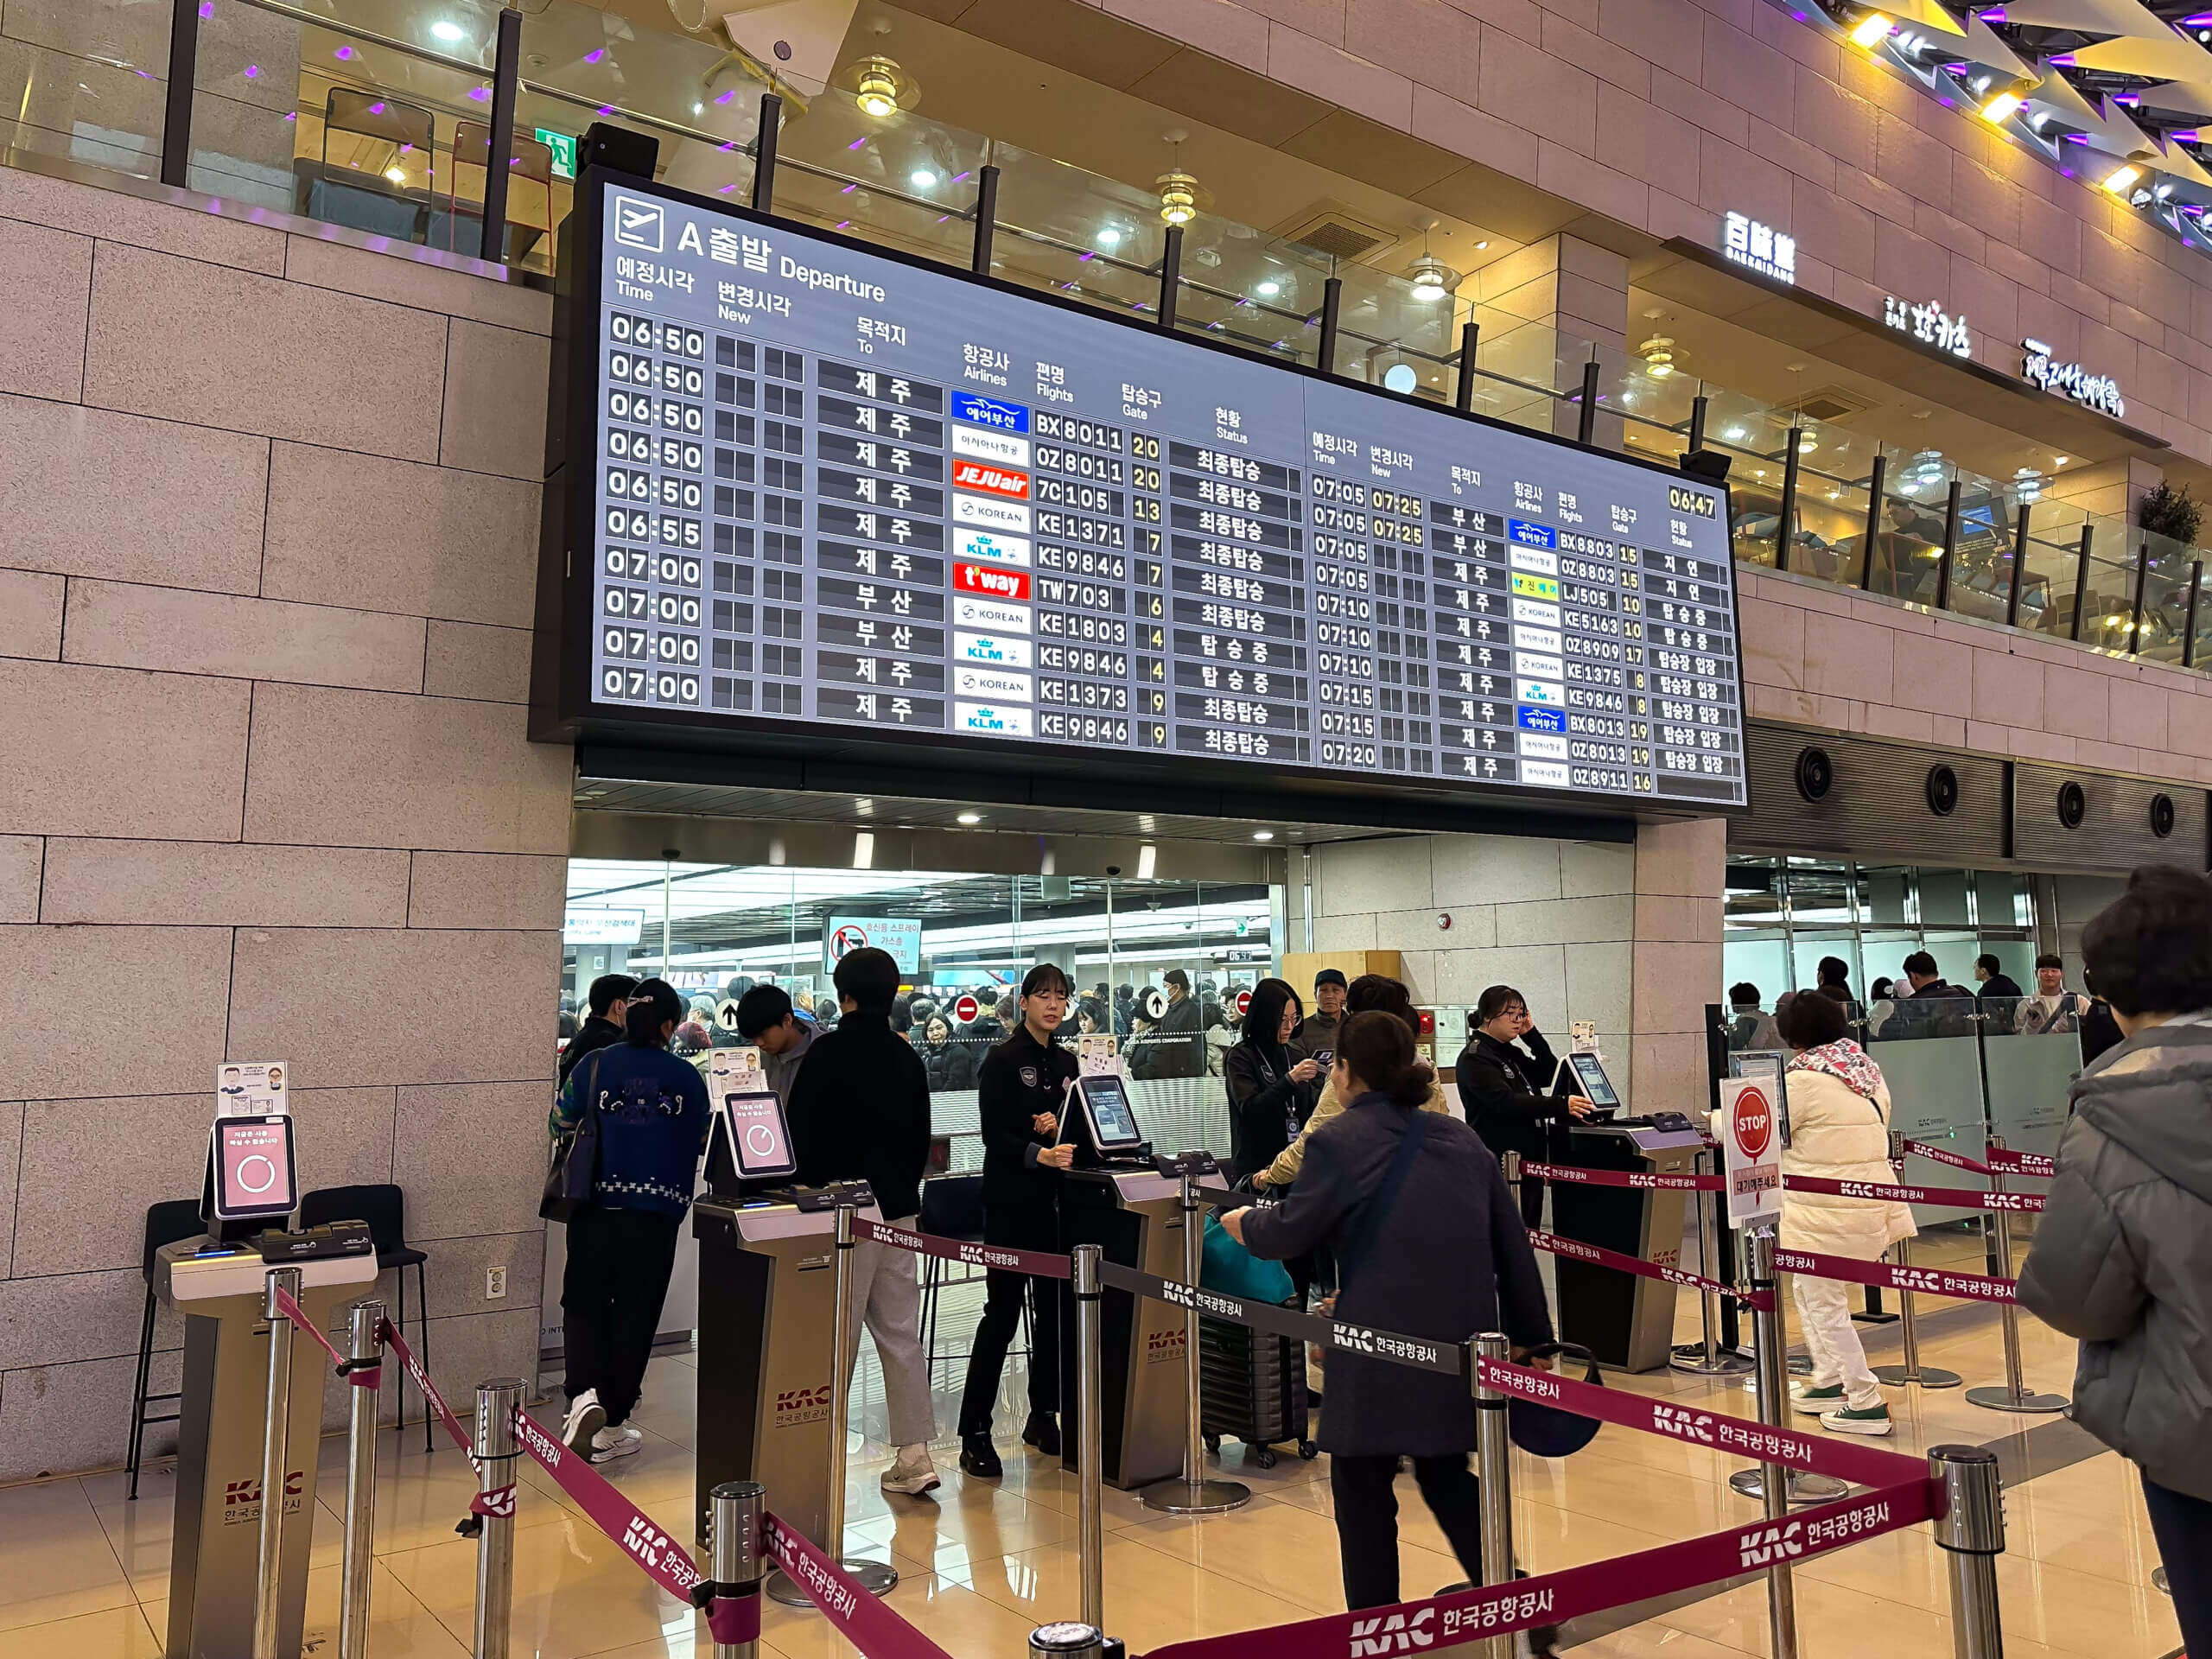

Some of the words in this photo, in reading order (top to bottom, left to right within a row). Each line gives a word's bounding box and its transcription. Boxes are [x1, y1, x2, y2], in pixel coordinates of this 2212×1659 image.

[677, 221, 703, 257] A
[709, 227, 772, 273] 출발
[780, 255, 887, 302] Departure
[616, 257, 695, 294] 예정시각
[616, 280, 654, 302] Time
[718, 281, 791, 318] 변경시각
[718, 305, 751, 325] New
[857, 316, 906, 347] 목적지
[857, 338, 874, 354] To
[963, 344, 1010, 371] 항공사
[963, 365, 1007, 387] Airlines
[1036, 361, 1065, 385] 편명
[612, 316, 703, 355] 06:50
[966, 405, 1015, 429] 에어부산
[1037, 414, 1122, 448] BX8011
[1133, 436, 1159, 458] 20
[1198, 450, 1262, 482] 최종탑승
[1037, 383, 1074, 404] Flights
[1122, 383, 1162, 409] 탑승구
[1122, 404, 1147, 421] Gate
[1215, 406, 1241, 429] 현황
[611, 354, 702, 393] 06:50
[1037, 448, 1122, 481] OZ8011
[1134, 468, 1160, 490] 20
[1198, 480, 1262, 512] 최종탑승
[1216, 426, 1248, 444] Status
[1313, 432, 1357, 456] 예정시각
[610, 393, 702, 430] 06:50
[956, 466, 1027, 494] JEJUair
[1039, 480, 1109, 511] 7C105
[1135, 499, 1160, 521] 13
[1199, 511, 1263, 542] 최종탑승
[1313, 450, 1336, 465] Time
[1370, 445, 1413, 470] 변경시각
[1371, 465, 1391, 478] New
[1452, 465, 1481, 487] 목적지
[1452, 482, 1462, 495] To
[1514, 480, 1543, 502] 항공사
[1558, 491, 1577, 509] 편명
[609, 432, 702, 468] 06:50
[977, 506, 1022, 523] KOREAN
[1039, 512, 1123, 544] KE1371
[1149, 533, 1161, 551] 7
[1200, 541, 1263, 572] 최종탑승
[1515, 499, 1542, 514] Airlines
[1611, 504, 1637, 524] 탑승구
[1669, 488, 1715, 516] 06:47
[1313, 479, 1364, 504] 07:05
[1372, 493, 1421, 516] 07:25
[1620, 545, 1637, 563] 15
[1314, 507, 1365, 531] 07:05
[1374, 522, 1422, 543] 07:25
[1559, 509, 1583, 524] Flights
[1612, 521, 1629, 534] Gate
[1669, 518, 1688, 536] 현황
[608, 471, 701, 506] 06:50
[967, 543, 1001, 558] KLM
[1039, 546, 1124, 577] KE9846
[1150, 567, 1161, 584] 7
[1201, 573, 1265, 602] 최종탑승
[1315, 536, 1367, 560] 07:05
[1671, 536, 1693, 549] Status
[607, 511, 700, 545] 06:55
[1039, 580, 1109, 608] TW703
[1151, 599, 1162, 616] 6
[1202, 604, 1266, 632] 최종탑승
[607, 551, 700, 583] 07:00
[979, 610, 1023, 623] KOREAN
[1039, 613, 1125, 643] KE1803
[1152, 631, 1163, 647] 4
[1316, 565, 1368, 589] 07:05
[1529, 608, 1555, 620] KOREAN
[1318, 594, 1369, 618] 07:10
[606, 590, 699, 622] 07:00
[967, 646, 1002, 661] KLM
[1039, 646, 1126, 675] KE9846
[1152, 664, 1164, 680] 4
[1319, 624, 1370, 646] 07:10
[1531, 661, 1558, 673] KOREAN
[605, 630, 699, 661] 07:00
[980, 678, 1024, 692] KOREAN
[1040, 680, 1127, 709] KE1373
[1153, 695, 1164, 711] 9
[1205, 698, 1268, 725] 최종탑승
[1319, 654, 1371, 677] 07:10
[1526, 690, 1548, 701] KLM
[1320, 683, 1372, 705] 07:15
[604, 671, 698, 700] 07:00
[968, 716, 1003, 731] KLM
[1040, 715, 1128, 741] KE9846
[1154, 727, 1165, 744] 9
[1205, 729, 1269, 755] 최종탑승
[1322, 713, 1374, 734] 07:15
[1323, 743, 1375, 765] 07:20
[1634, 775, 1651, 791] 16
[890, 924, 919, 933] 스프레이
[1738, 1114, 1767, 1132] STOP
[1914, 1143, 1934, 1159] KAC
[1990, 1160, 2019, 1173] KAC
[1526, 1163, 1550, 1177] KAC
[1630, 1174, 1656, 1187] KAC
[1840, 1181, 1873, 1197] KAC
[1984, 1193, 2021, 1209] KAC
[873, 1224, 893, 1243] KAC
[959, 1243, 983, 1263] KAC
[1891, 1267, 1940, 1292] KAC
[1944, 1277, 2017, 1299] 한국공항공사
[1163, 1281, 1194, 1306] KAC
[1196, 1292, 1243, 1318] 한국공항공사
[1333, 1323, 1374, 1353] KAC
[1376, 1336, 1437, 1363] 한국공항공사
[1147, 1328, 1185, 1350] KAC
[777, 1385, 830, 1412] KAC
[1489, 1365, 1560, 1401] 한국공항공사
[1651, 1404, 1713, 1442] KAC
[1719, 1423, 1813, 1463] 한국공항공사
[525, 1423, 562, 1469] 한국공항공사
[622, 1514, 669, 1568] KAC
[1739, 1521, 1802, 1568] KAC
[1807, 1501, 1890, 1547] 한국공항공사
[798, 1551, 858, 1621] 한국공항공사
[1349, 1607, 1434, 1659] KAC
[1443, 1588, 1554, 1637] 한국공항공사
